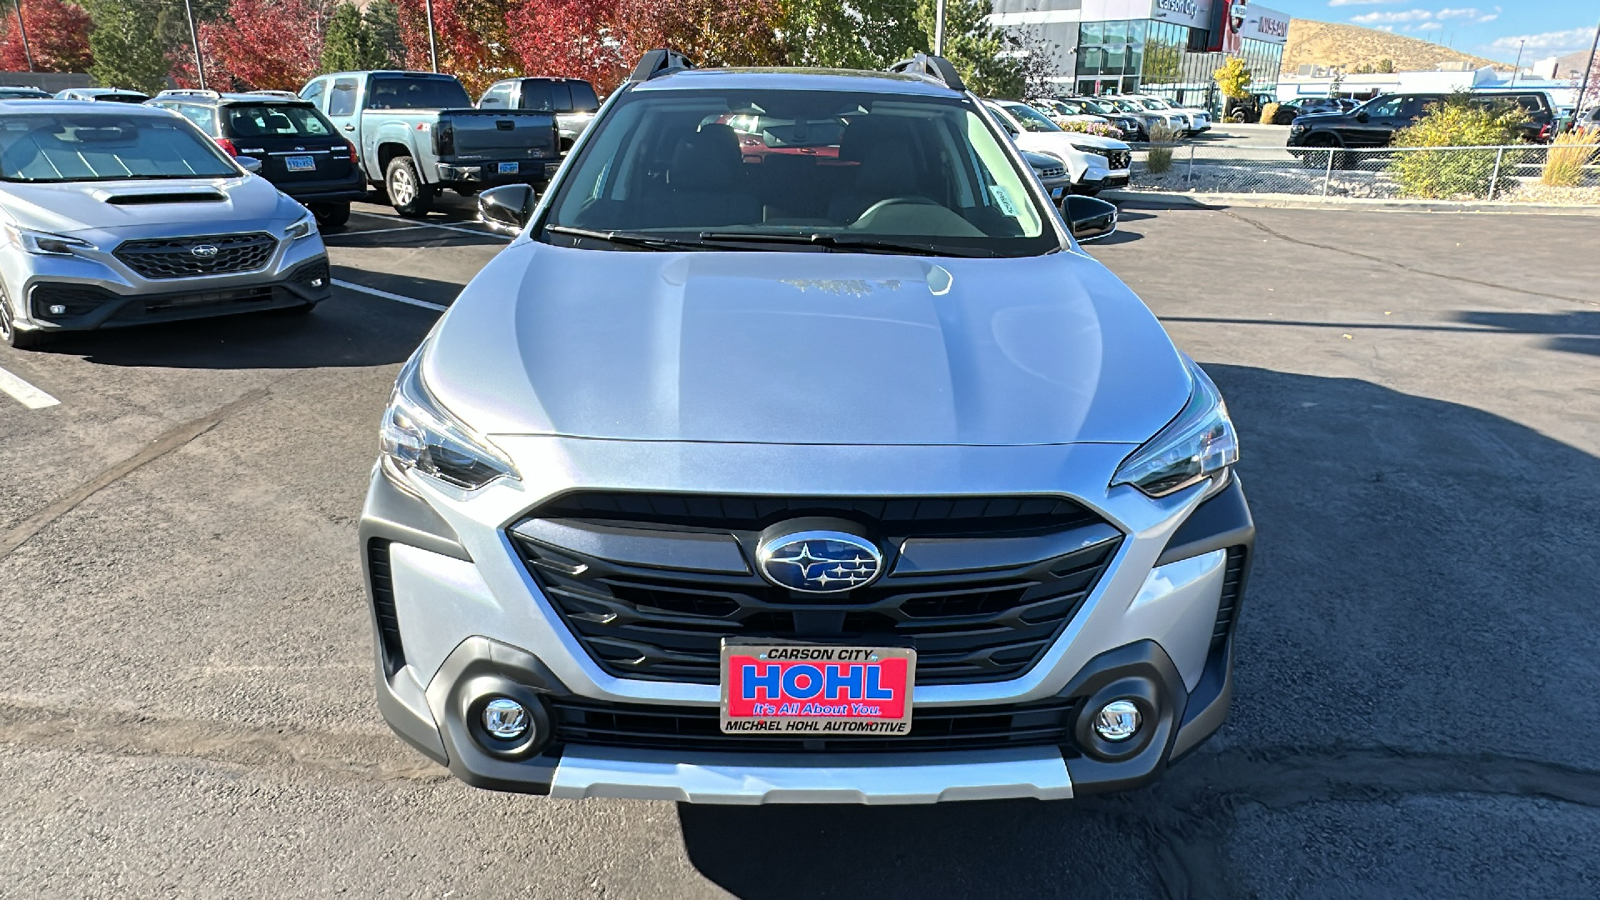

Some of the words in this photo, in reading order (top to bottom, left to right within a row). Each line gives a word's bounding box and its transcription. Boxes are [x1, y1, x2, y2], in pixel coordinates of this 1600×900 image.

[1185, 0, 1199, 19] City
[1258, 16, 1287, 37] NISSAN
[767, 649, 832, 660] CARSON
[837, 649, 873, 661] CITY
[742, 664, 893, 700] HOHL
[753, 703, 776, 715] It's
[779, 703, 799, 715] All
[802, 703, 847, 715] About
[851, 703, 882, 716] You.
[725, 720, 782, 731] MICHAEL
[785, 721, 820, 732] HOHL
[822, 721, 907, 732] AUTOMOTIVE
